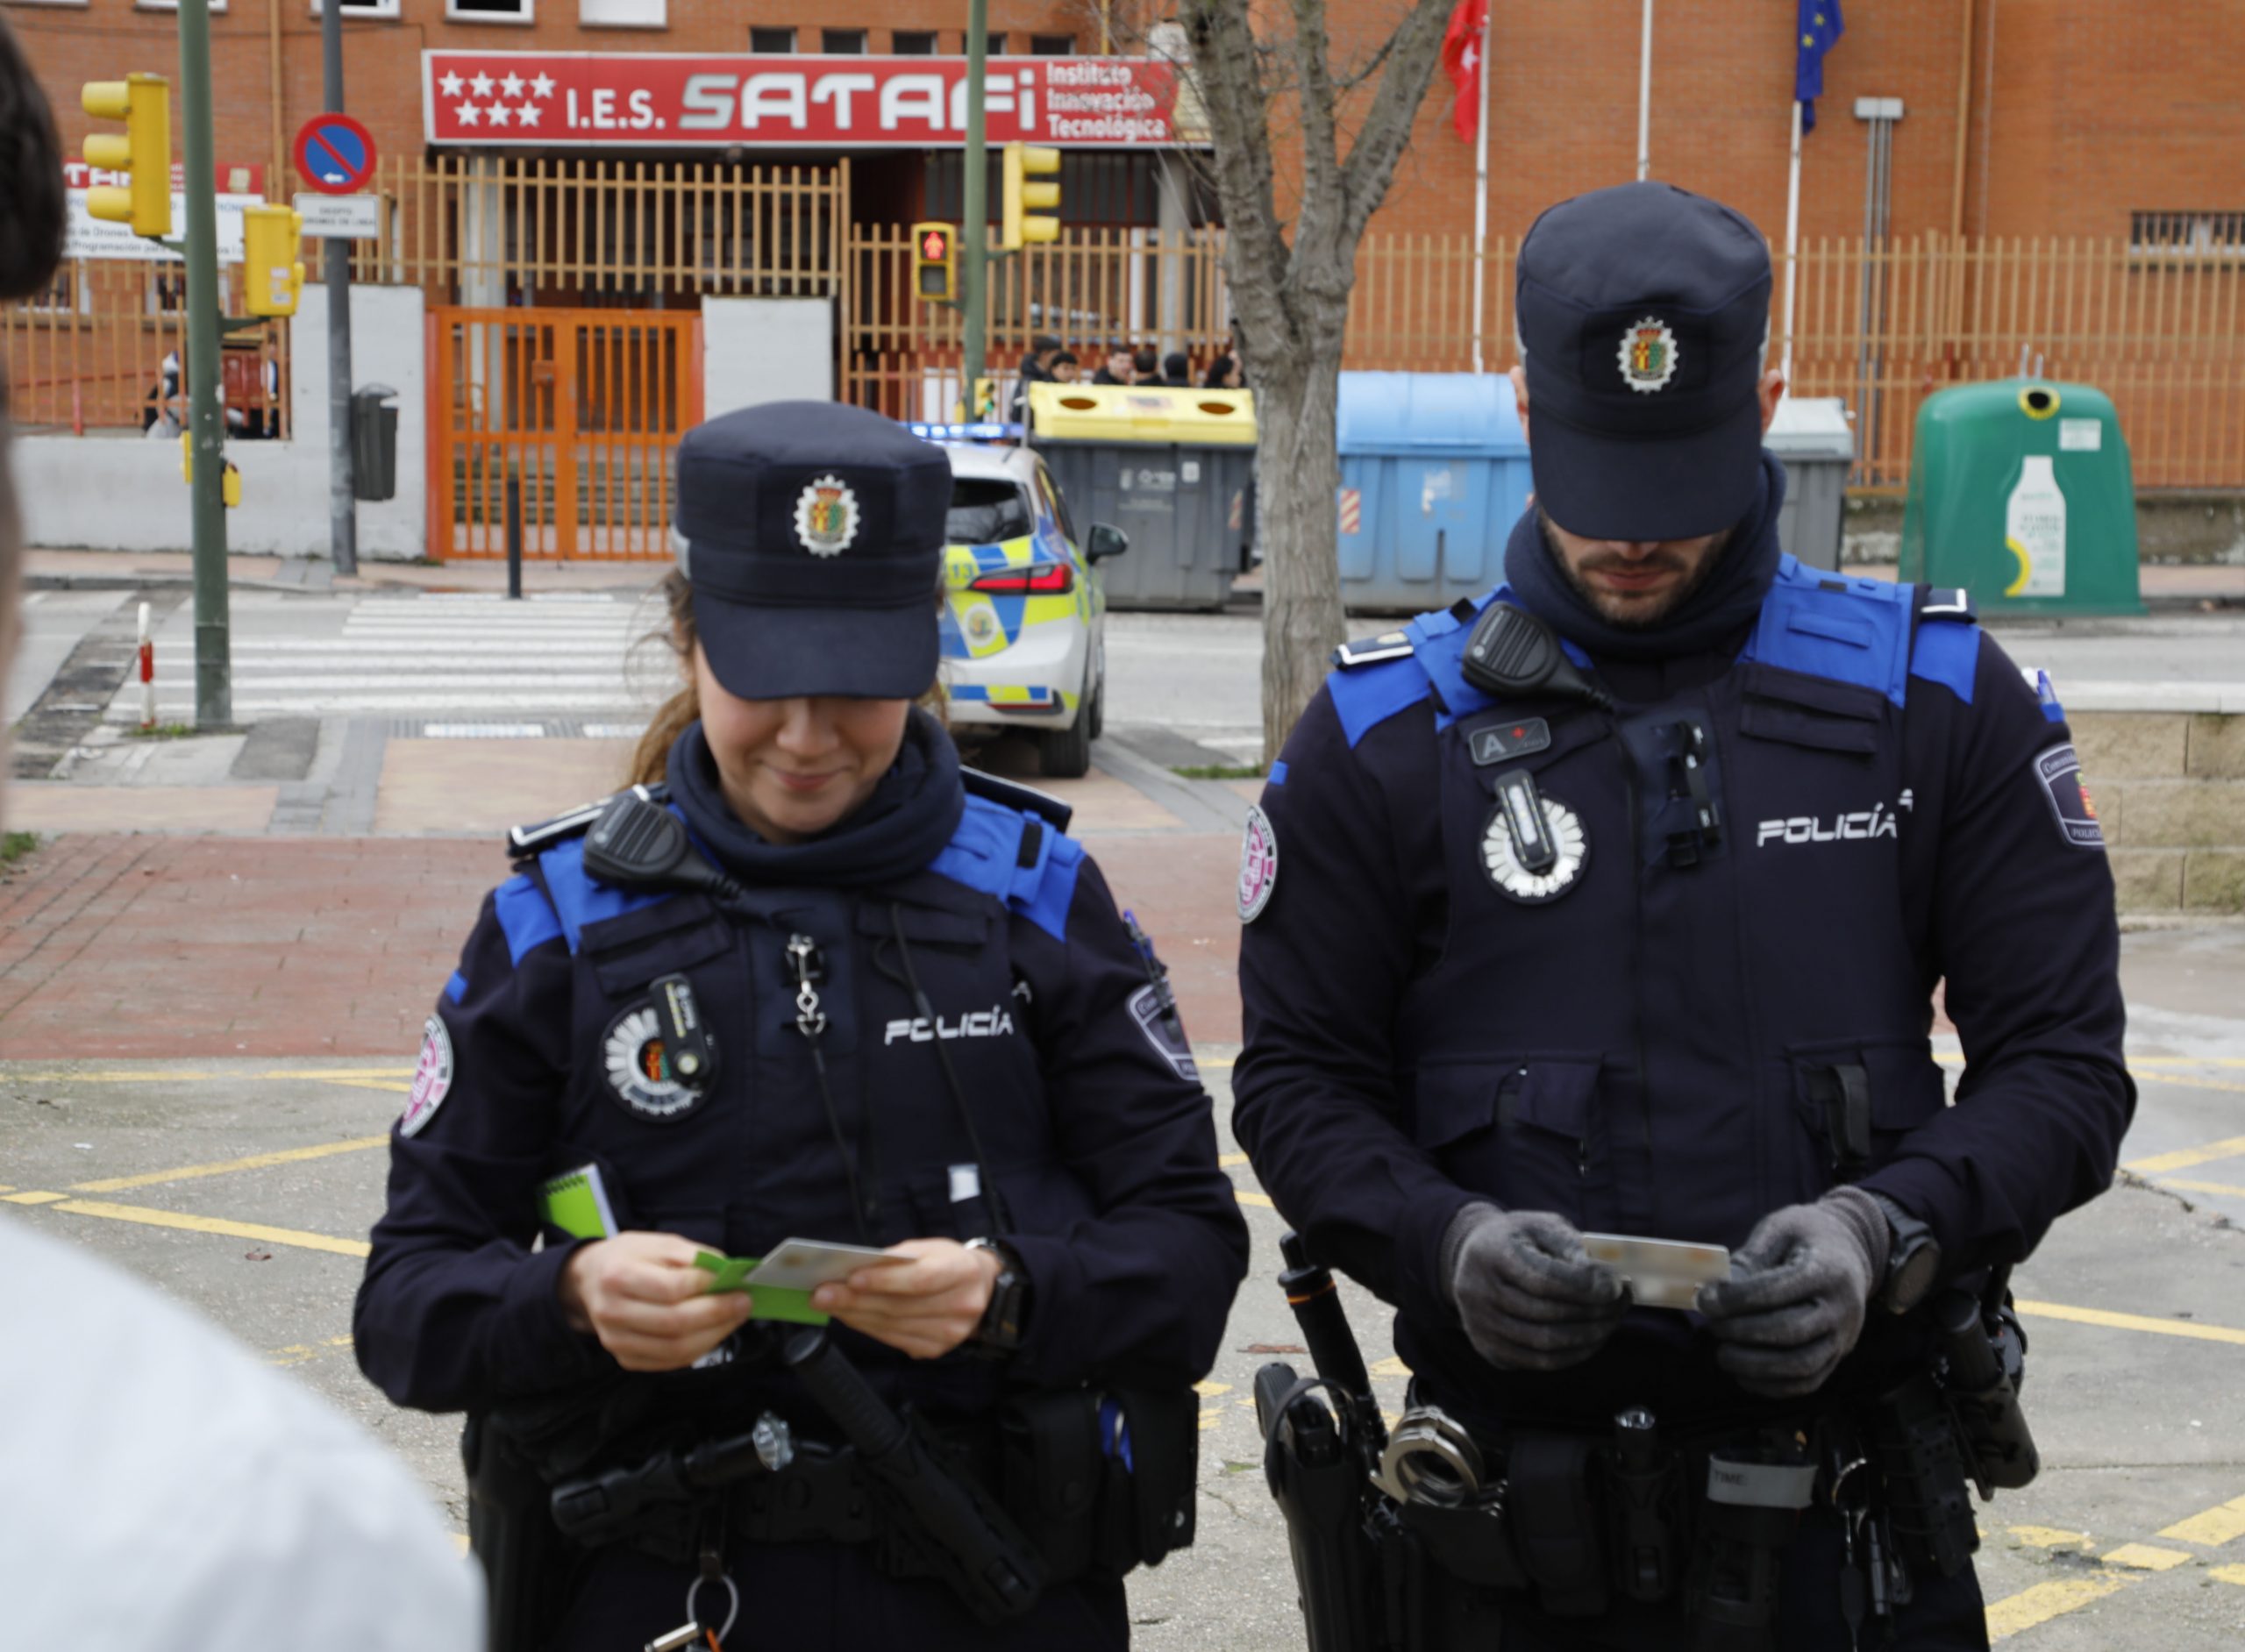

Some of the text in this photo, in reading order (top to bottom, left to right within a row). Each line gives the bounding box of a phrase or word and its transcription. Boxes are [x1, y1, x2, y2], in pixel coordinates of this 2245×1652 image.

[1046, 62, 1132, 86] Instituto
[567, 88, 666, 129] I.E.S.
[1046, 86, 1156, 111] Innovación
[1046, 114, 1165, 141] Tecnológica
[1757, 801, 1897, 847] POLICÍA
